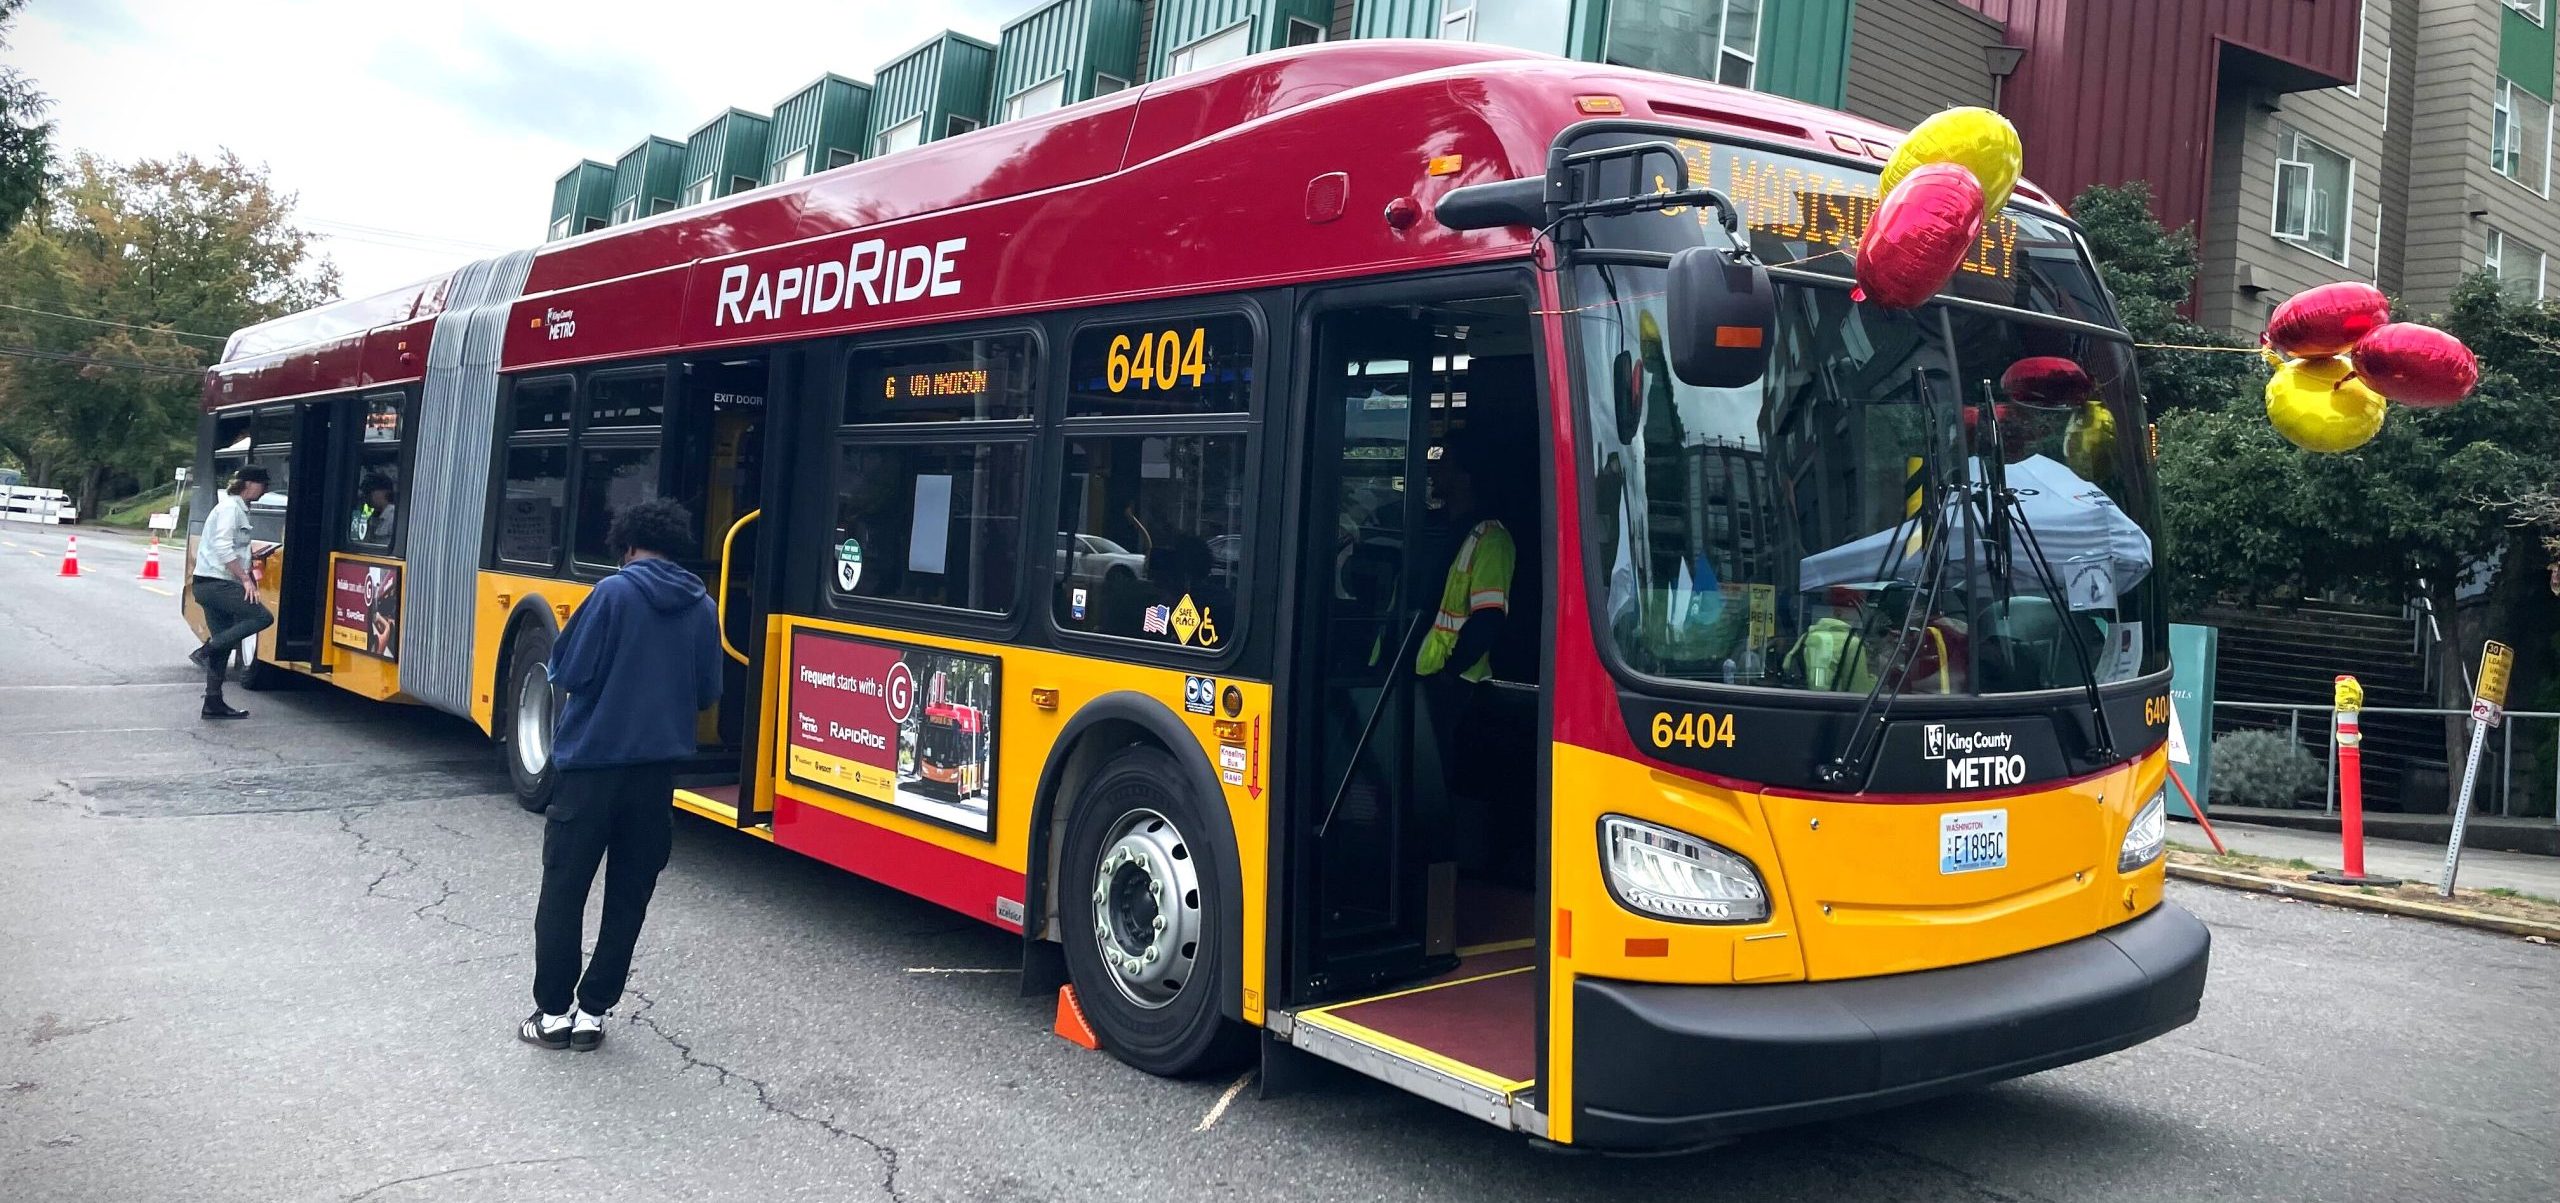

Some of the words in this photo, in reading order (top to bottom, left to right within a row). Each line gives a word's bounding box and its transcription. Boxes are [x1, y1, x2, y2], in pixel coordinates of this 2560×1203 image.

[548, 320, 576, 340] METRO
[1106, 328, 1206, 393] 6404
[886, 376, 896, 398] G
[910, 375, 930, 396] VIA
[934, 370, 987, 395] MADISON
[714, 393, 734, 403] EXIT
[736, 395, 763, 406] DOOR
[1175, 616, 1195, 626] PLACE
[1179, 608, 1193, 617] SAFE
[2488, 644, 2499, 654] 30
[800, 665, 836, 689] Frequent
[837, 674, 858, 692] starts
[858, 677, 876, 696] with
[877, 683, 883, 697] a
[829, 721, 886, 750] RAPIDRIDE
[1651, 712, 1736, 748] 6404
[1946, 732, 1973, 753] King
[1974, 731, 2012, 752] County
[1221, 748, 1245, 761] Kneeling
[1228, 759, 1238, 767] Bus
[1224, 772, 1242, 782] RAMP
[1946, 754, 2026, 789] METRO
[1945, 822, 1984, 832] WASHINGTON
[1954, 831, 2004, 864] E1895C
